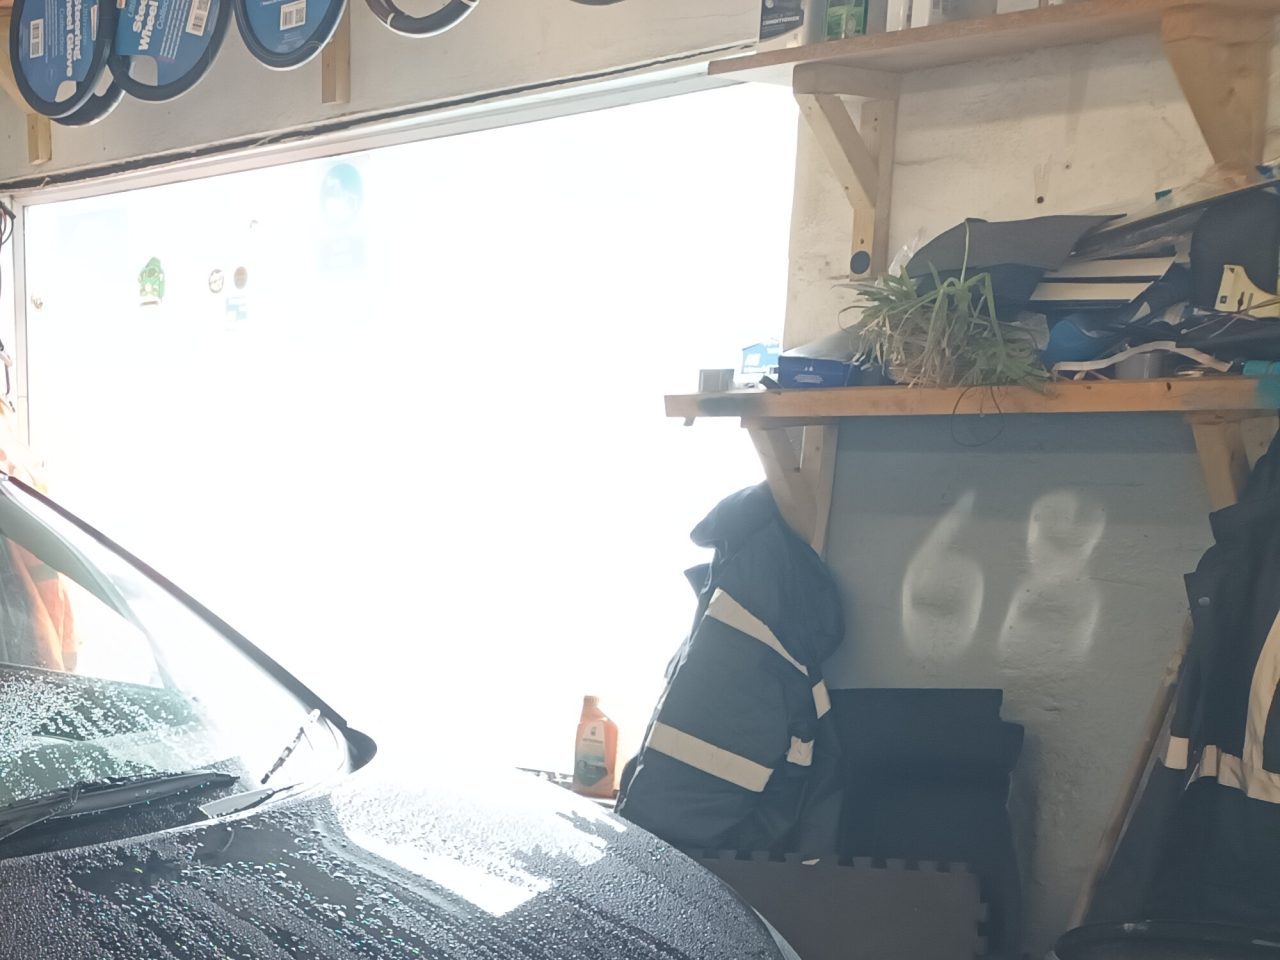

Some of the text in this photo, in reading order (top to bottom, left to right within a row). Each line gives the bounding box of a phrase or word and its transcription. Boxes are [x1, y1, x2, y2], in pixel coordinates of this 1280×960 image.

[138, 0, 159, 50] Wheel
[65, 33, 74, 77] Glove
[902, 490, 1106, 663] 68
